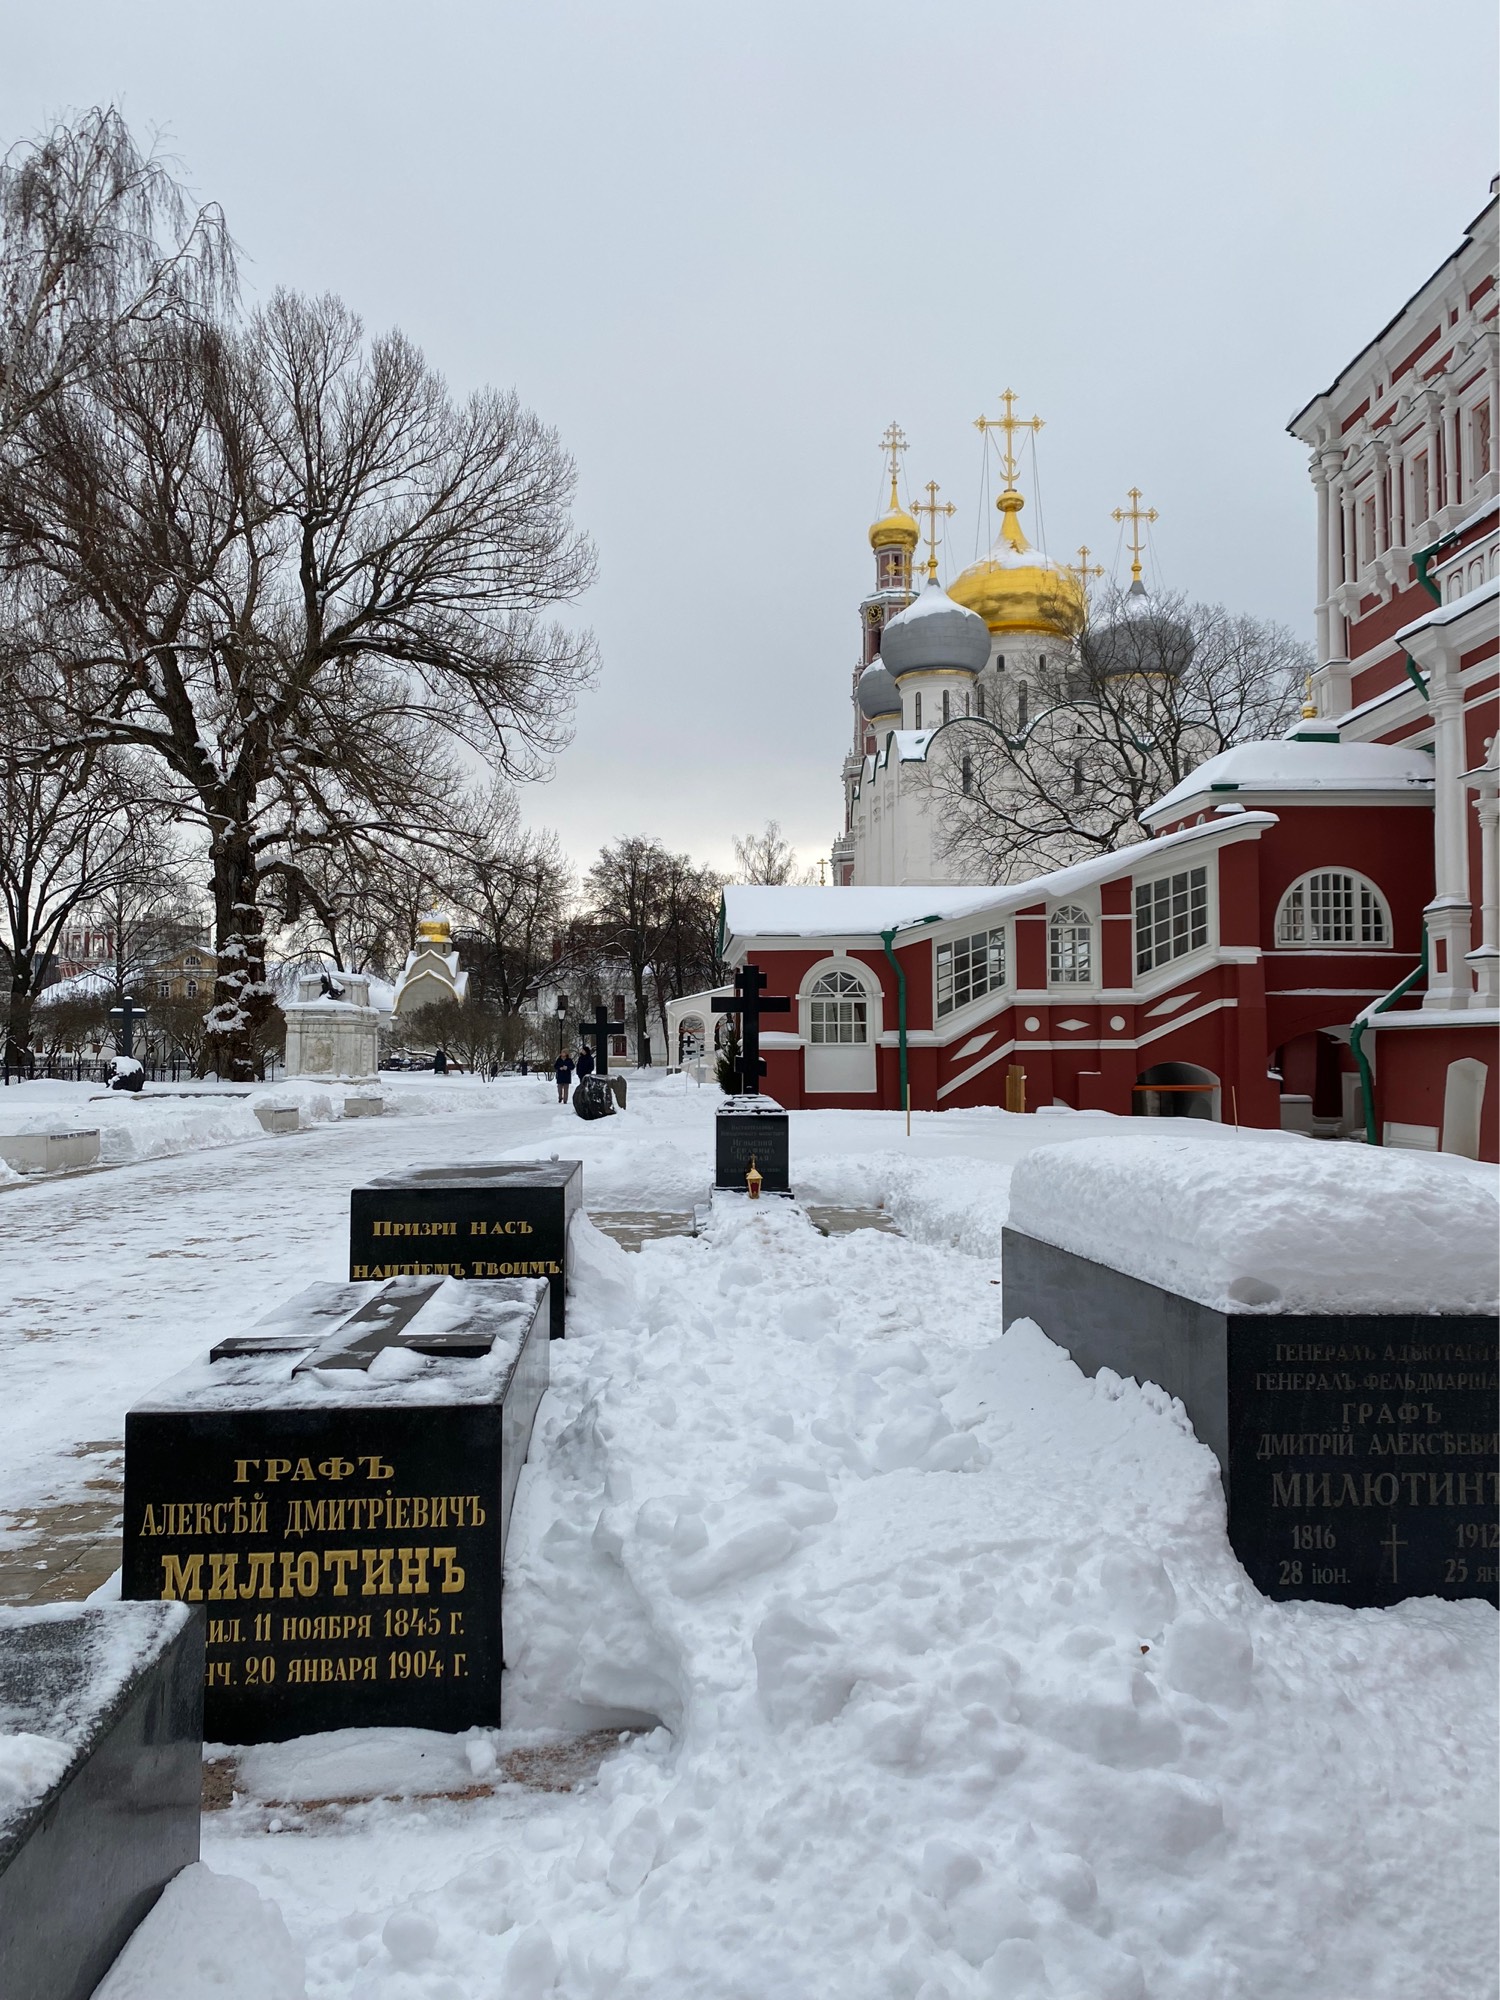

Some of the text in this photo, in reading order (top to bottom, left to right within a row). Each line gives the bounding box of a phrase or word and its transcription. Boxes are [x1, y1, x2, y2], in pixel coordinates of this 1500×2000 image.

[1342, 1403, 1442, 1424] ГРАФЪ
[233, 1456, 395, 1483] ГРАФЪ
[1292, 1525, 1337, 1550] 1816
[1456, 1524, 1500, 1548] 1912
[161, 1547, 466, 1601] МИЛЮТИНЪ
[1279, 1560, 1303, 1585] 28
[1444, 1559, 1469, 1583] 25
[205, 1618, 246, 1648] ИЛ.
[254, 1613, 271, 1641] 11
[384, 1608, 441, 1637] 1845
[245, 1655, 275, 1685] 20
[388, 1650, 444, 1680] 1904
